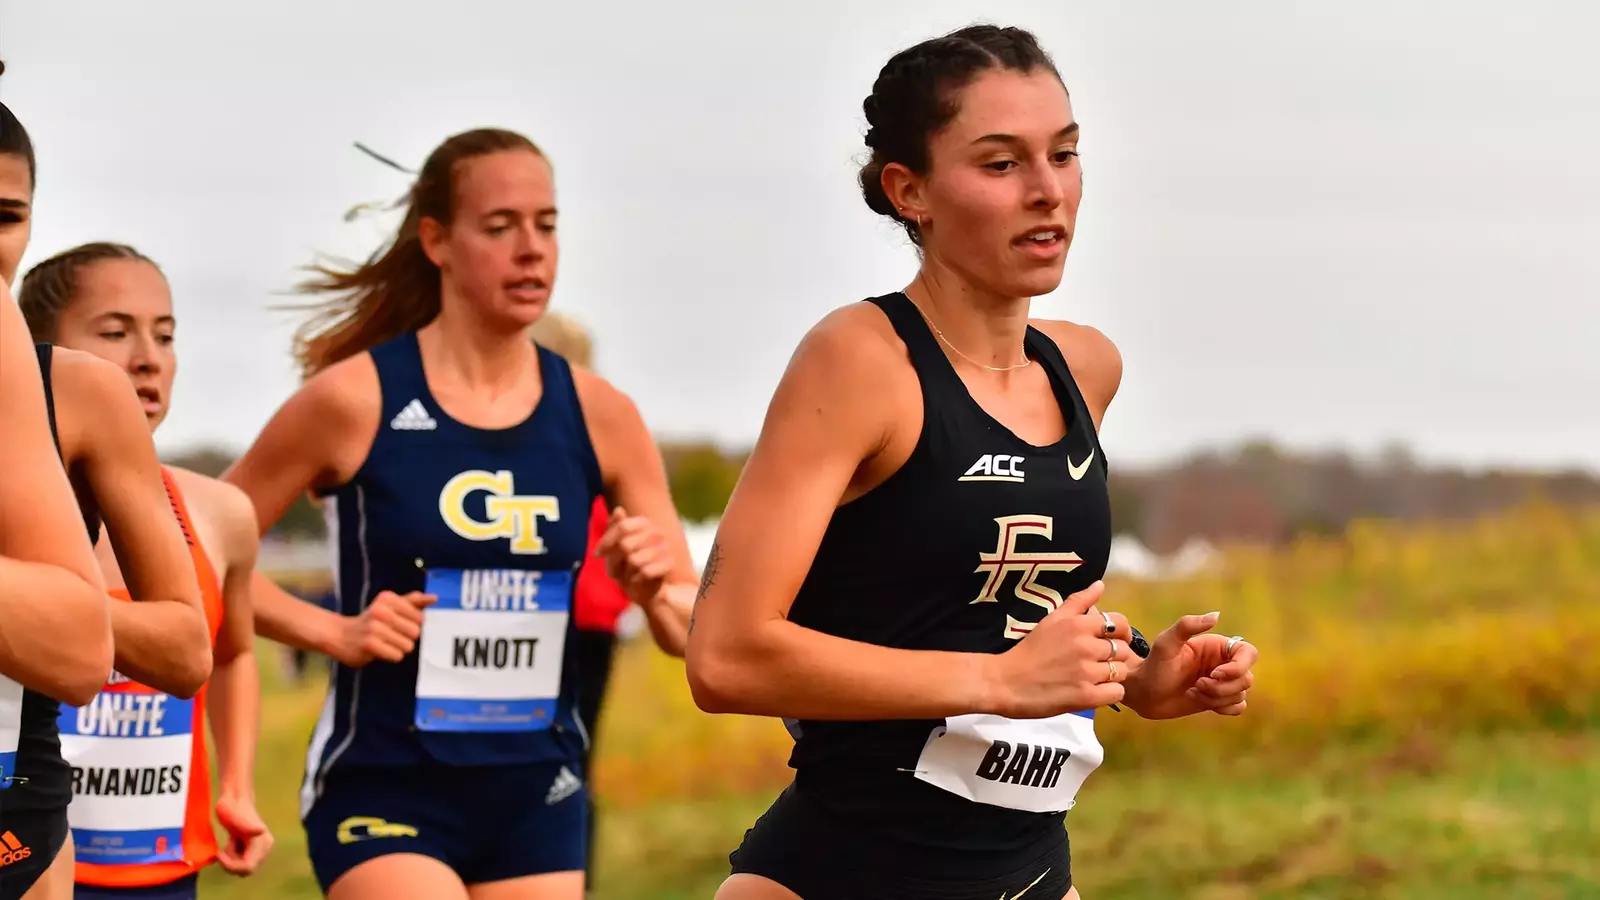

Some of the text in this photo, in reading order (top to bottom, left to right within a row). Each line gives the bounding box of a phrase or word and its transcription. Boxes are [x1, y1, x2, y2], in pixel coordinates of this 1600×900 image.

[964, 454, 1026, 478] ACC
[438, 469, 560, 555] GT
[460, 569, 542, 611] UNITE
[453, 637, 539, 668] KNOTT
[77, 692, 168, 736] UNITE
[70, 765, 183, 796] RNANDES
[975, 739, 1071, 788] BAHR
